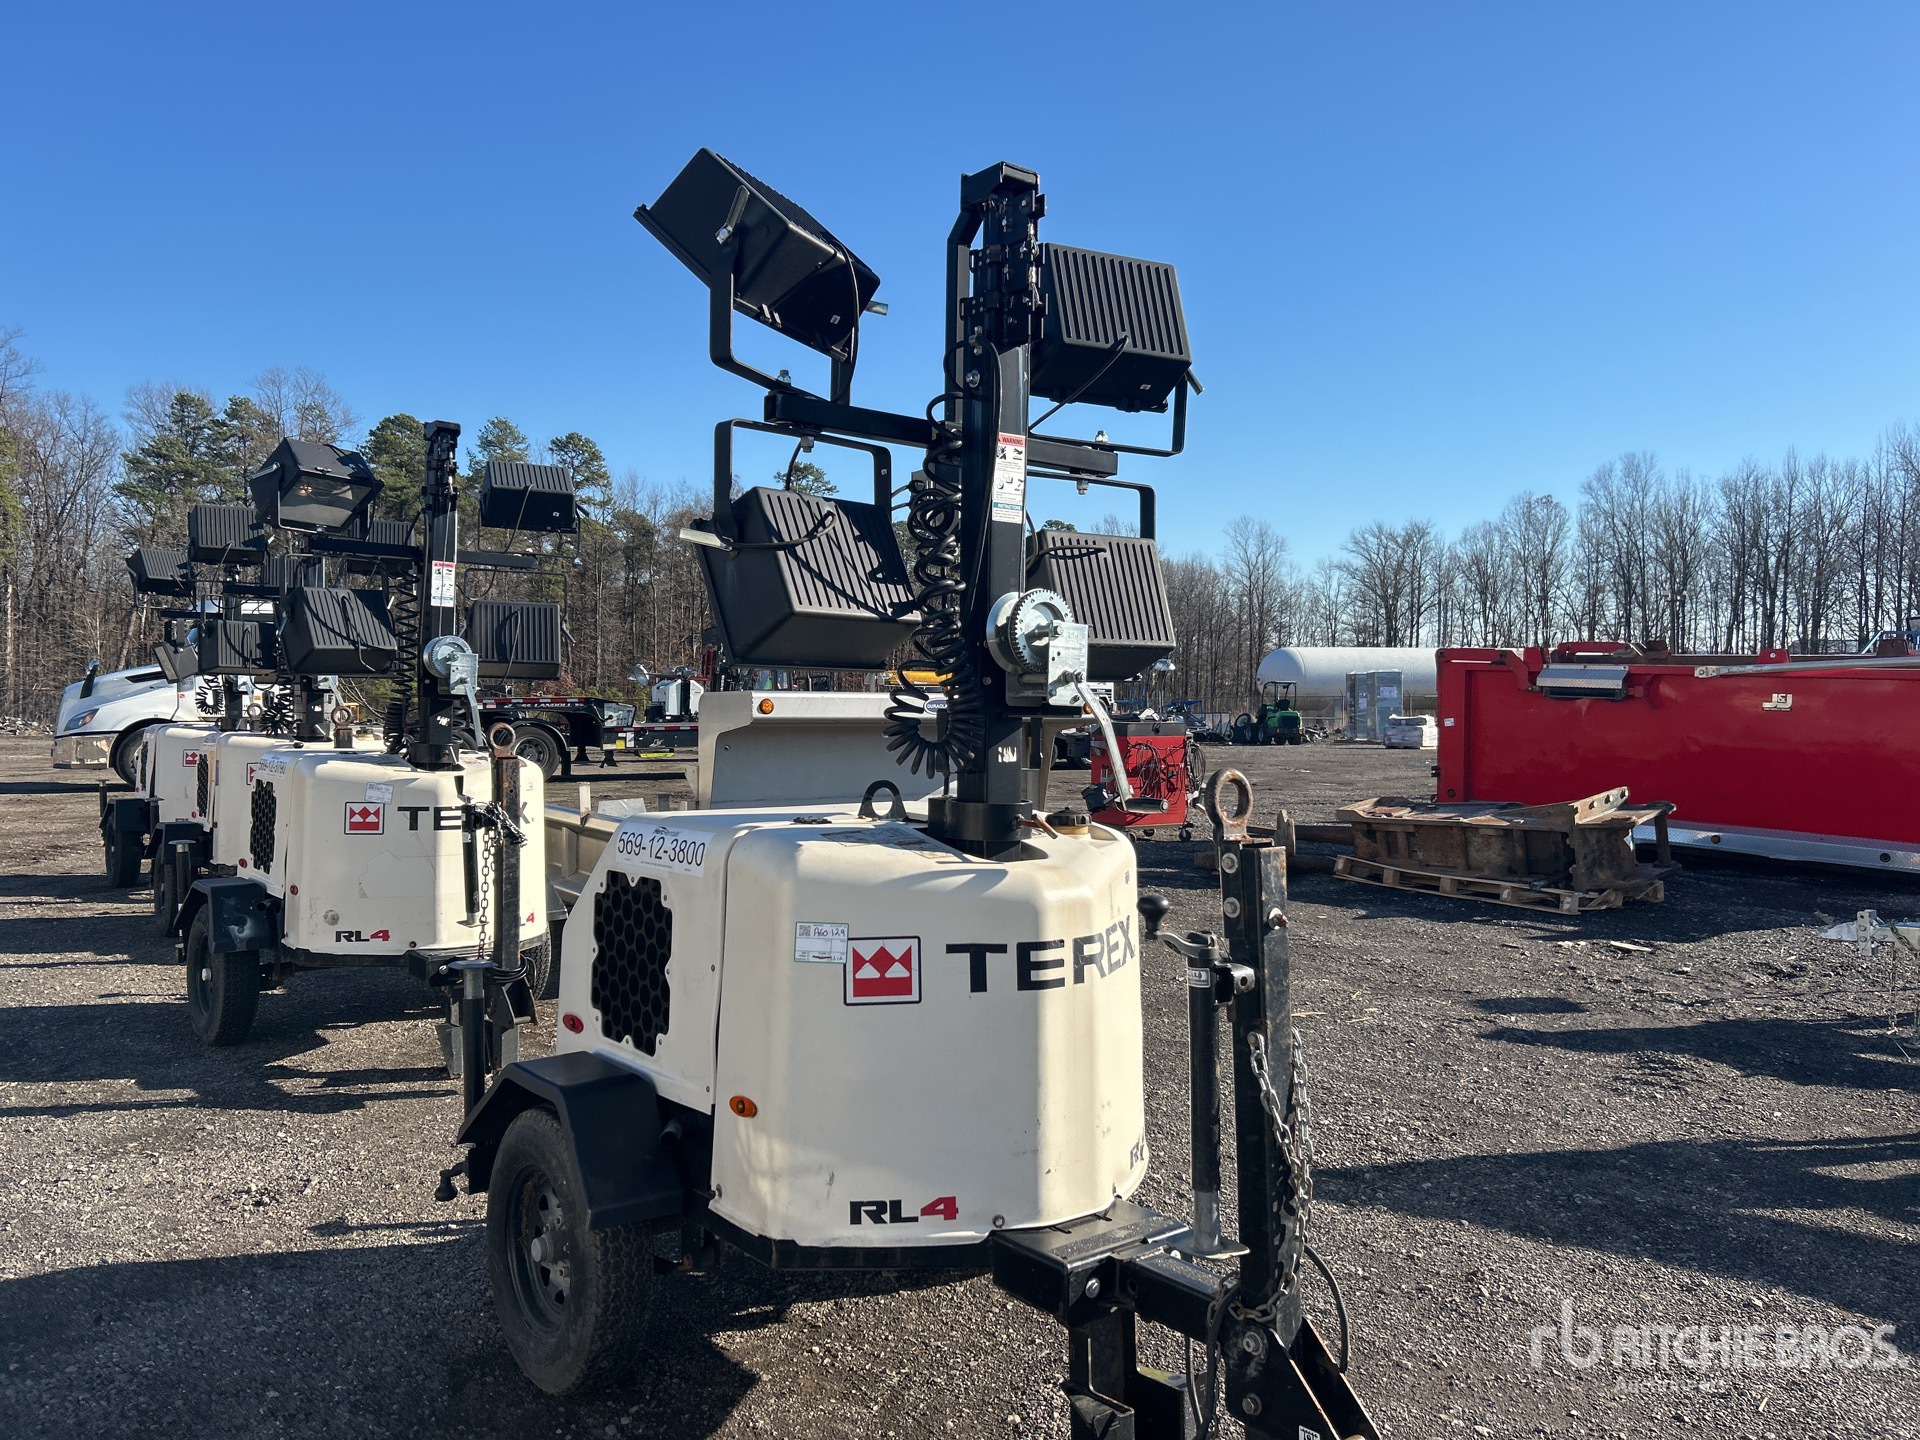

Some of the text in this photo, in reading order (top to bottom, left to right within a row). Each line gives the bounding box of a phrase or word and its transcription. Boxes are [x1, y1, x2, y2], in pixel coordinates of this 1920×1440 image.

[1002, 436, 1024, 446] WARNING
[617, 831, 706, 867] 569-12-3800
[335, 929, 391, 943] RL4
[945, 914, 1136, 994] TEREX
[849, 1195, 960, 1226] RL4
